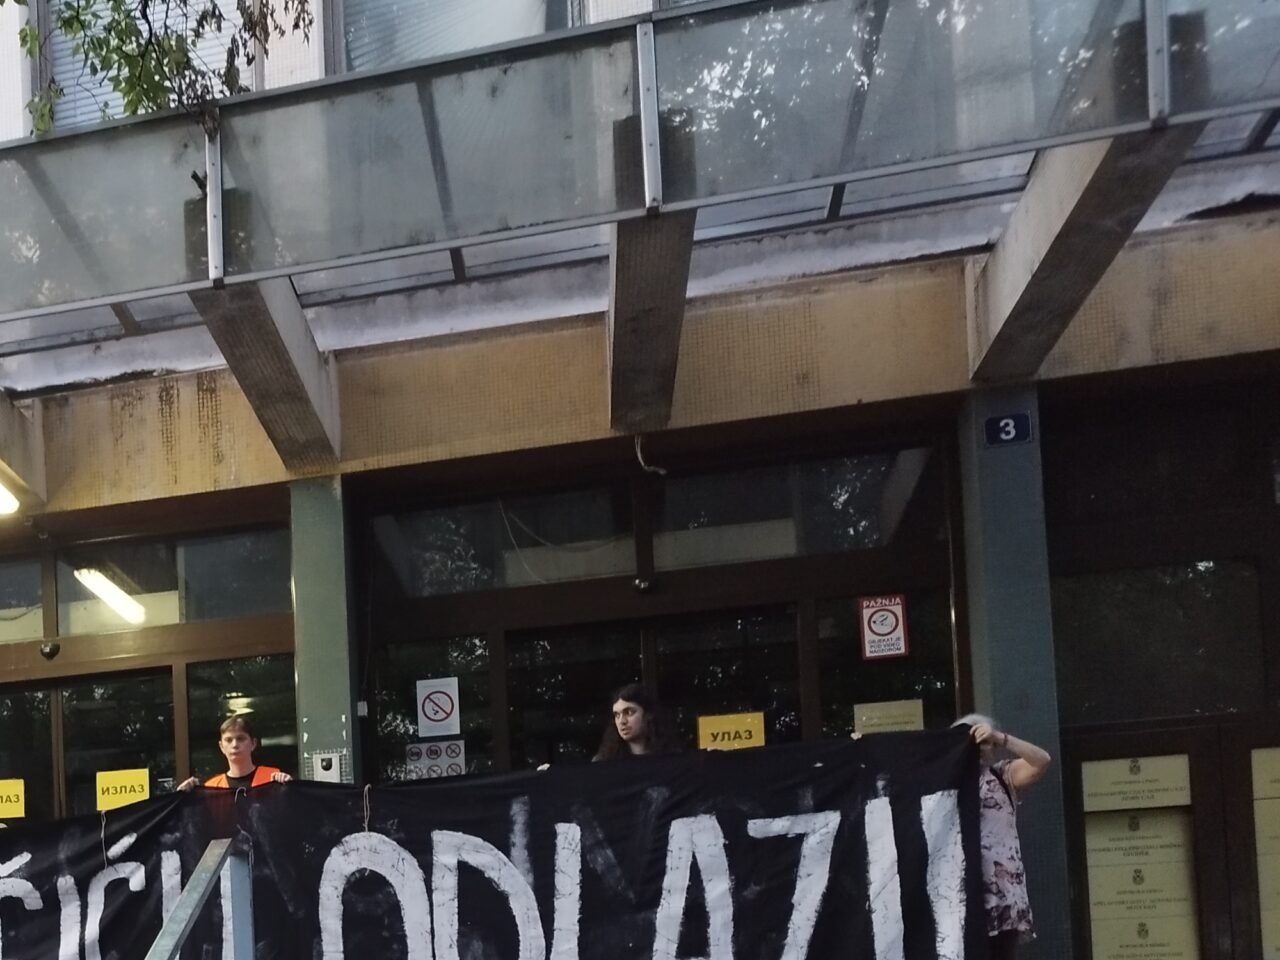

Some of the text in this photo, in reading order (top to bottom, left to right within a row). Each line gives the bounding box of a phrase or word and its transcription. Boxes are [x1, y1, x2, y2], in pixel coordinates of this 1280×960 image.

[999, 418, 1016, 440] 3
[863, 597, 902, 608] PAŽNJA
[710, 729, 753, 743] УЛАЗ
[101, 784, 145, 796] ИЗЛАЗ
